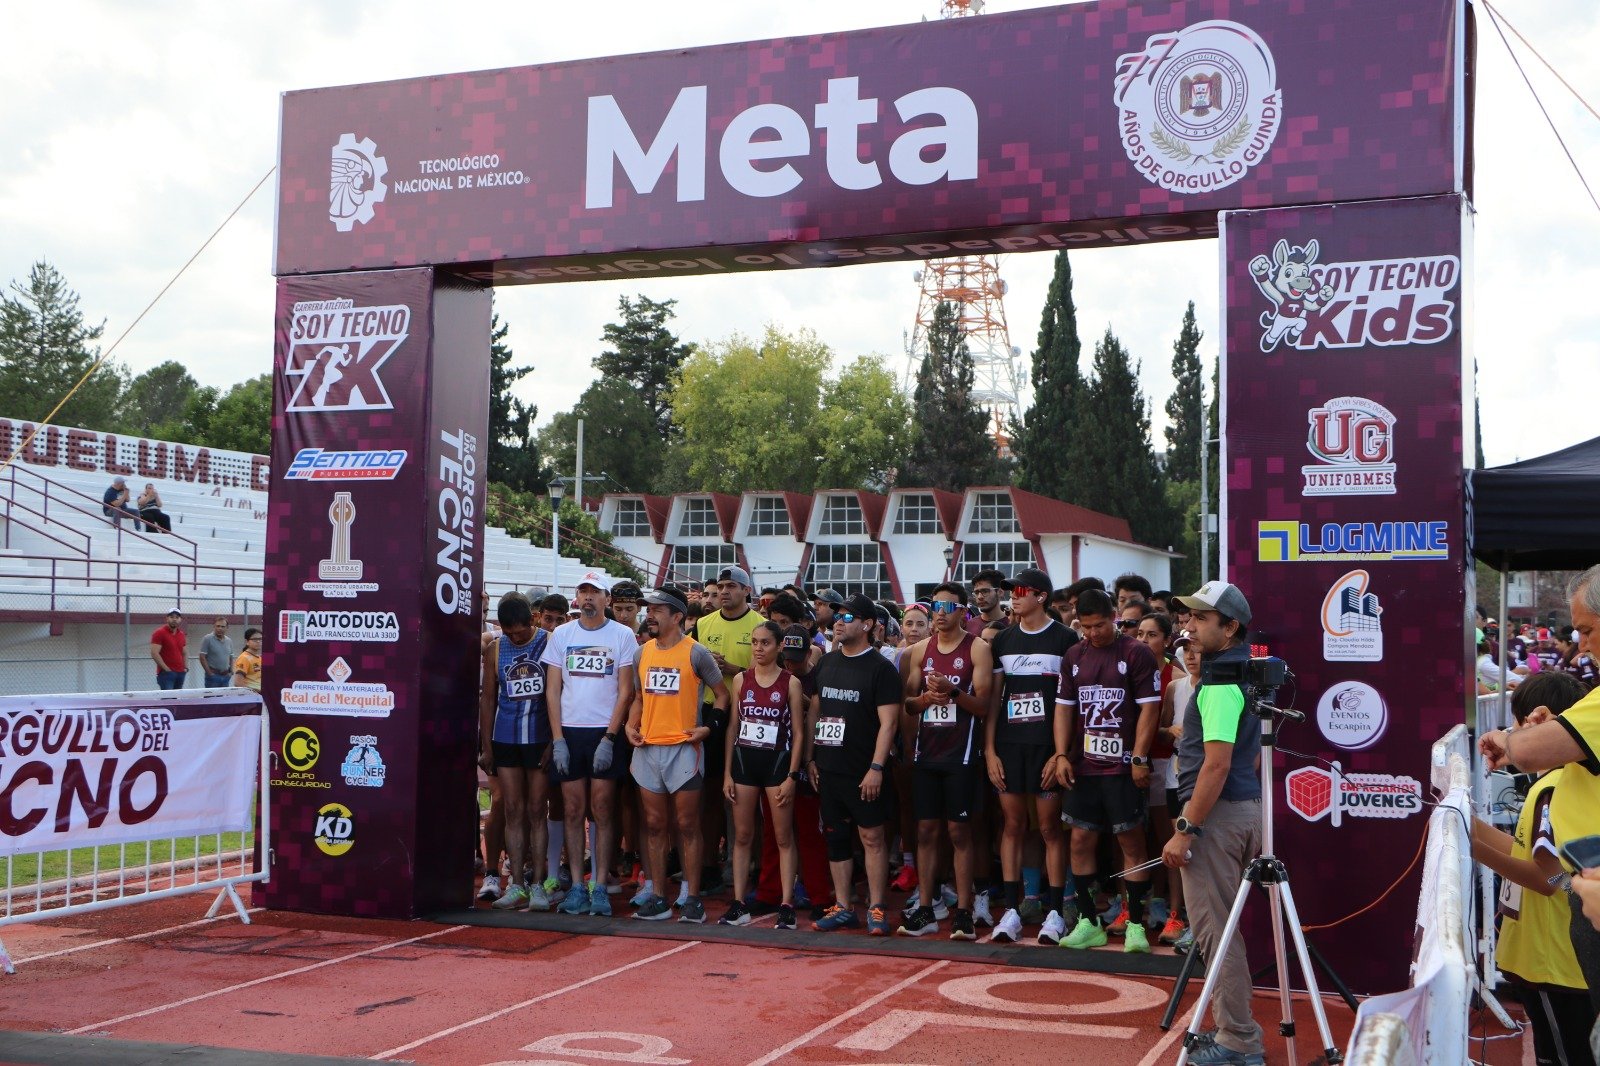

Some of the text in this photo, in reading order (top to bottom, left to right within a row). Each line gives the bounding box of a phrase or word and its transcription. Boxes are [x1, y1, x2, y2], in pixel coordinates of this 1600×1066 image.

[585, 76, 979, 209] Meta
[1124, 93, 1277, 189] AÑOS DE ORGULLO GUINDA
[419, 154, 500, 174] TECNOLÓGICO
[394, 178, 453, 194] NACIONAL
[458, 175, 473, 189] DE
[1309, 259, 1456, 296] SOY TECNO
[295, 299, 353, 312] CARRERA ATLÉTICA
[293, 309, 407, 339] SOY TECNO
[1300, 294, 1450, 346] Kids
[464, 432, 470, 454] UN
[469, 435, 476, 453] ES
[1312, 410, 1390, 465] UG
[292, 450, 404, 468] SENTIDO
[1309, 473, 1392, 487] UNIFORMES
[436, 428, 464, 615] TECNO
[460, 454, 476, 590] ORGULLO
[1299, 520, 1449, 552] LOGMINE
[458, 589, 466, 614] DEL
[464, 590, 472, 616] SER
[306, 614, 396, 629] AUTODUSA
[306, 630, 324, 638] BLVD.
[362, 631, 379, 639] VILLA
[380, 631, 397, 639] 3300
[576, 656, 604, 671] 243
[342, 685, 385, 693] MATERIALES
[514, 679, 541, 695] 265
[651, 674, 677, 688] 127
[283, 692, 392, 708] Real del Mezquital
[821, 686, 860, 703] DURANGO
[1080, 689, 1123, 701] SOY TECNO
[743, 705, 780, 717] TECNO
[1014, 699, 1041, 716] 278
[140, 713, 171, 731] SER
[351, 735, 377, 743] PASIÓN
[756, 726, 765, 739] 3
[820, 724, 841, 739] 128
[141, 733, 170, 752] DEL
[1091, 738, 1120, 754] 180
[286, 772, 315, 780] GRUPO
[342, 766, 385, 777] RUNNER
[270, 780, 331, 789] CONSEGURIDAD
[346, 776, 384, 787] CYCLING
[1340, 782, 1416, 794] EMPRESARIOS
[315, 816, 353, 839] KD
